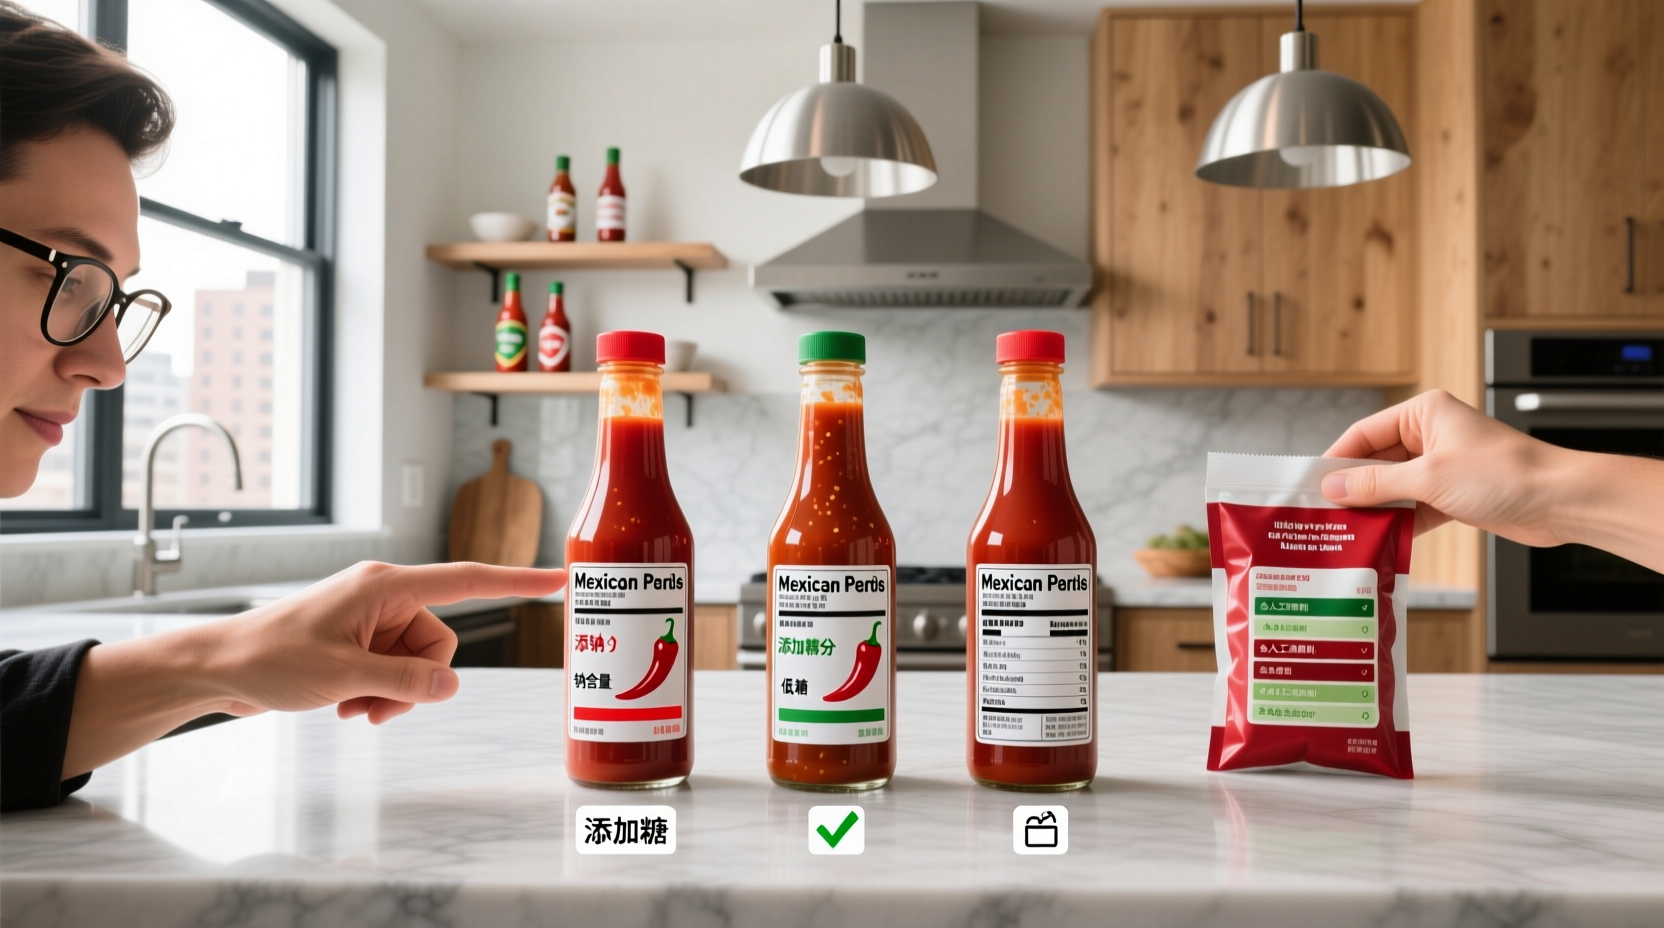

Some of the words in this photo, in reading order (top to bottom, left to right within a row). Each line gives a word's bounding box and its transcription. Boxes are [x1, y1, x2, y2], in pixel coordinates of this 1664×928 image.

[575, 573, 637, 590] Mexican
[779, 576, 840, 592] Mexican
[982, 574, 1042, 591] Mexican
